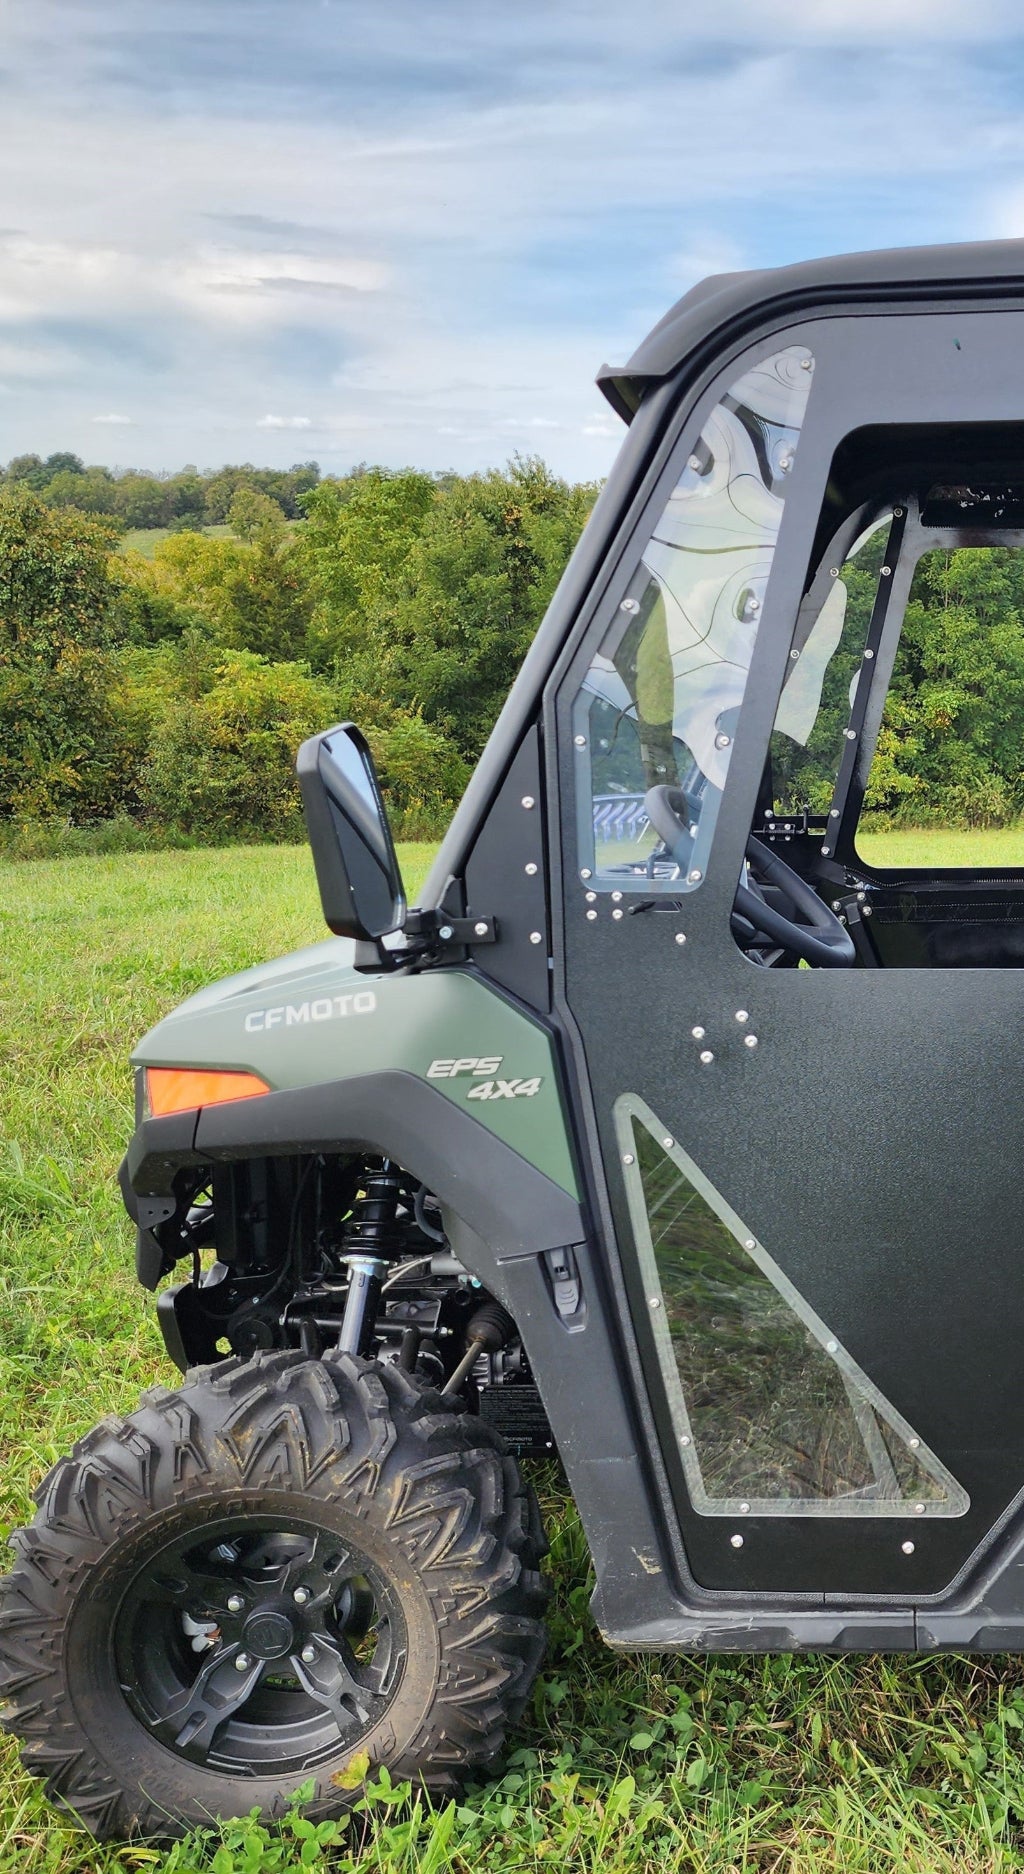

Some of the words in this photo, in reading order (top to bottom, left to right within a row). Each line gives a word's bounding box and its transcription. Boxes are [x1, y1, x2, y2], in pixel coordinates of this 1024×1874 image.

[244, 991, 377, 1033] CFMOTO
[426, 1056, 504, 1078] EPS
[466, 1077, 544, 1101] 4X4
